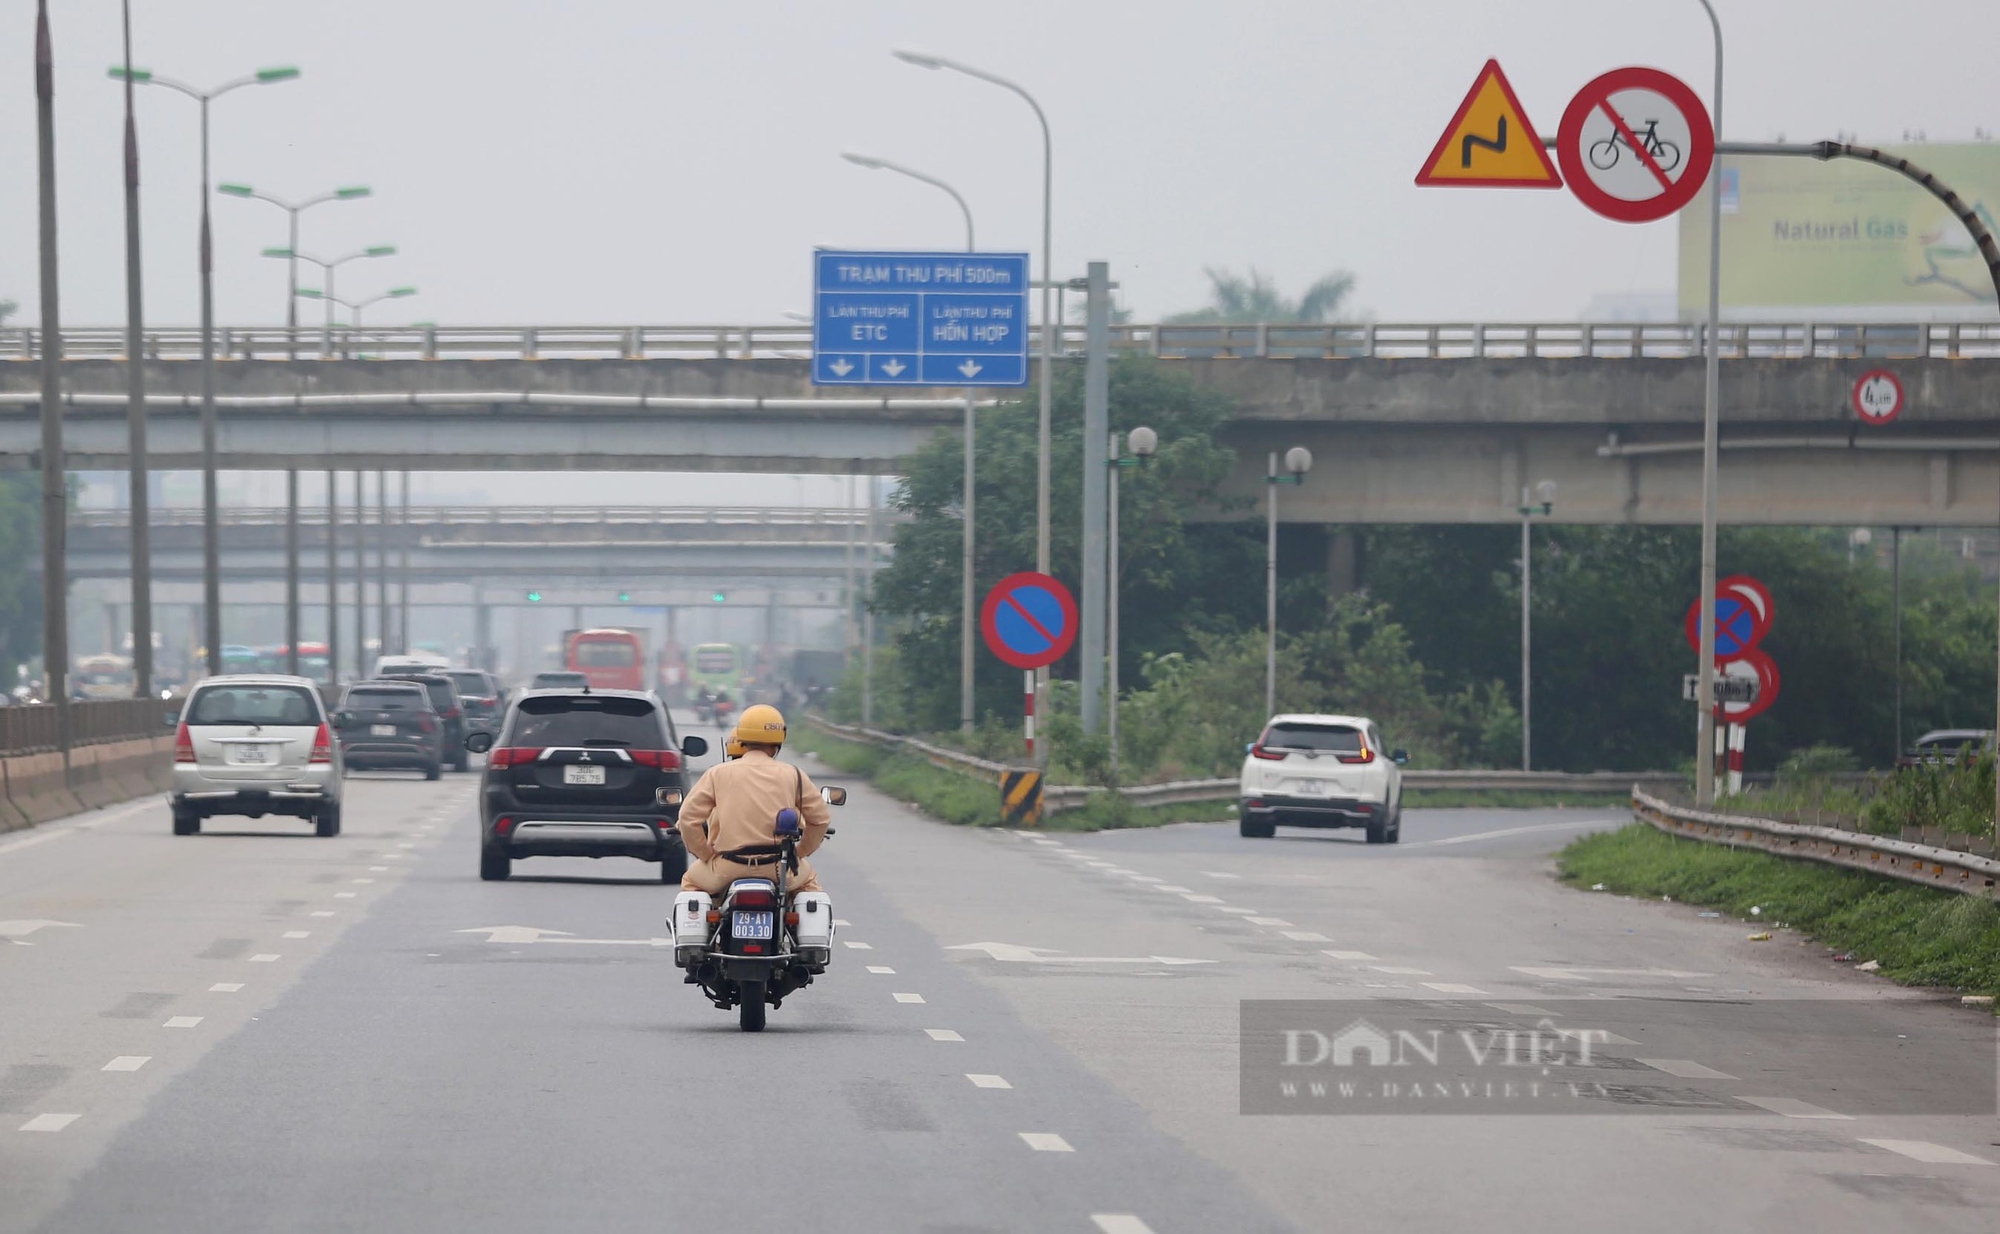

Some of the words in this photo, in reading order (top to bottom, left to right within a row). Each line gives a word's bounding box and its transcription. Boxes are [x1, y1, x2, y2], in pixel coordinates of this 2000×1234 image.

[1773, 219, 1860, 241] Natural
[1865, 219, 1910, 240] Gas
[838, 266, 891, 285] TRẠM
[896, 266, 931, 283] THU
[934, 263, 964, 283] PHÍ
[966, 266, 1011, 284] 500m
[859, 306, 887, 318] THU
[961, 306, 988, 319] THU
[851, 324, 888, 341] ETC
[738, 912, 767, 925] 29-A1
[735, 924, 770, 937] 003.30
